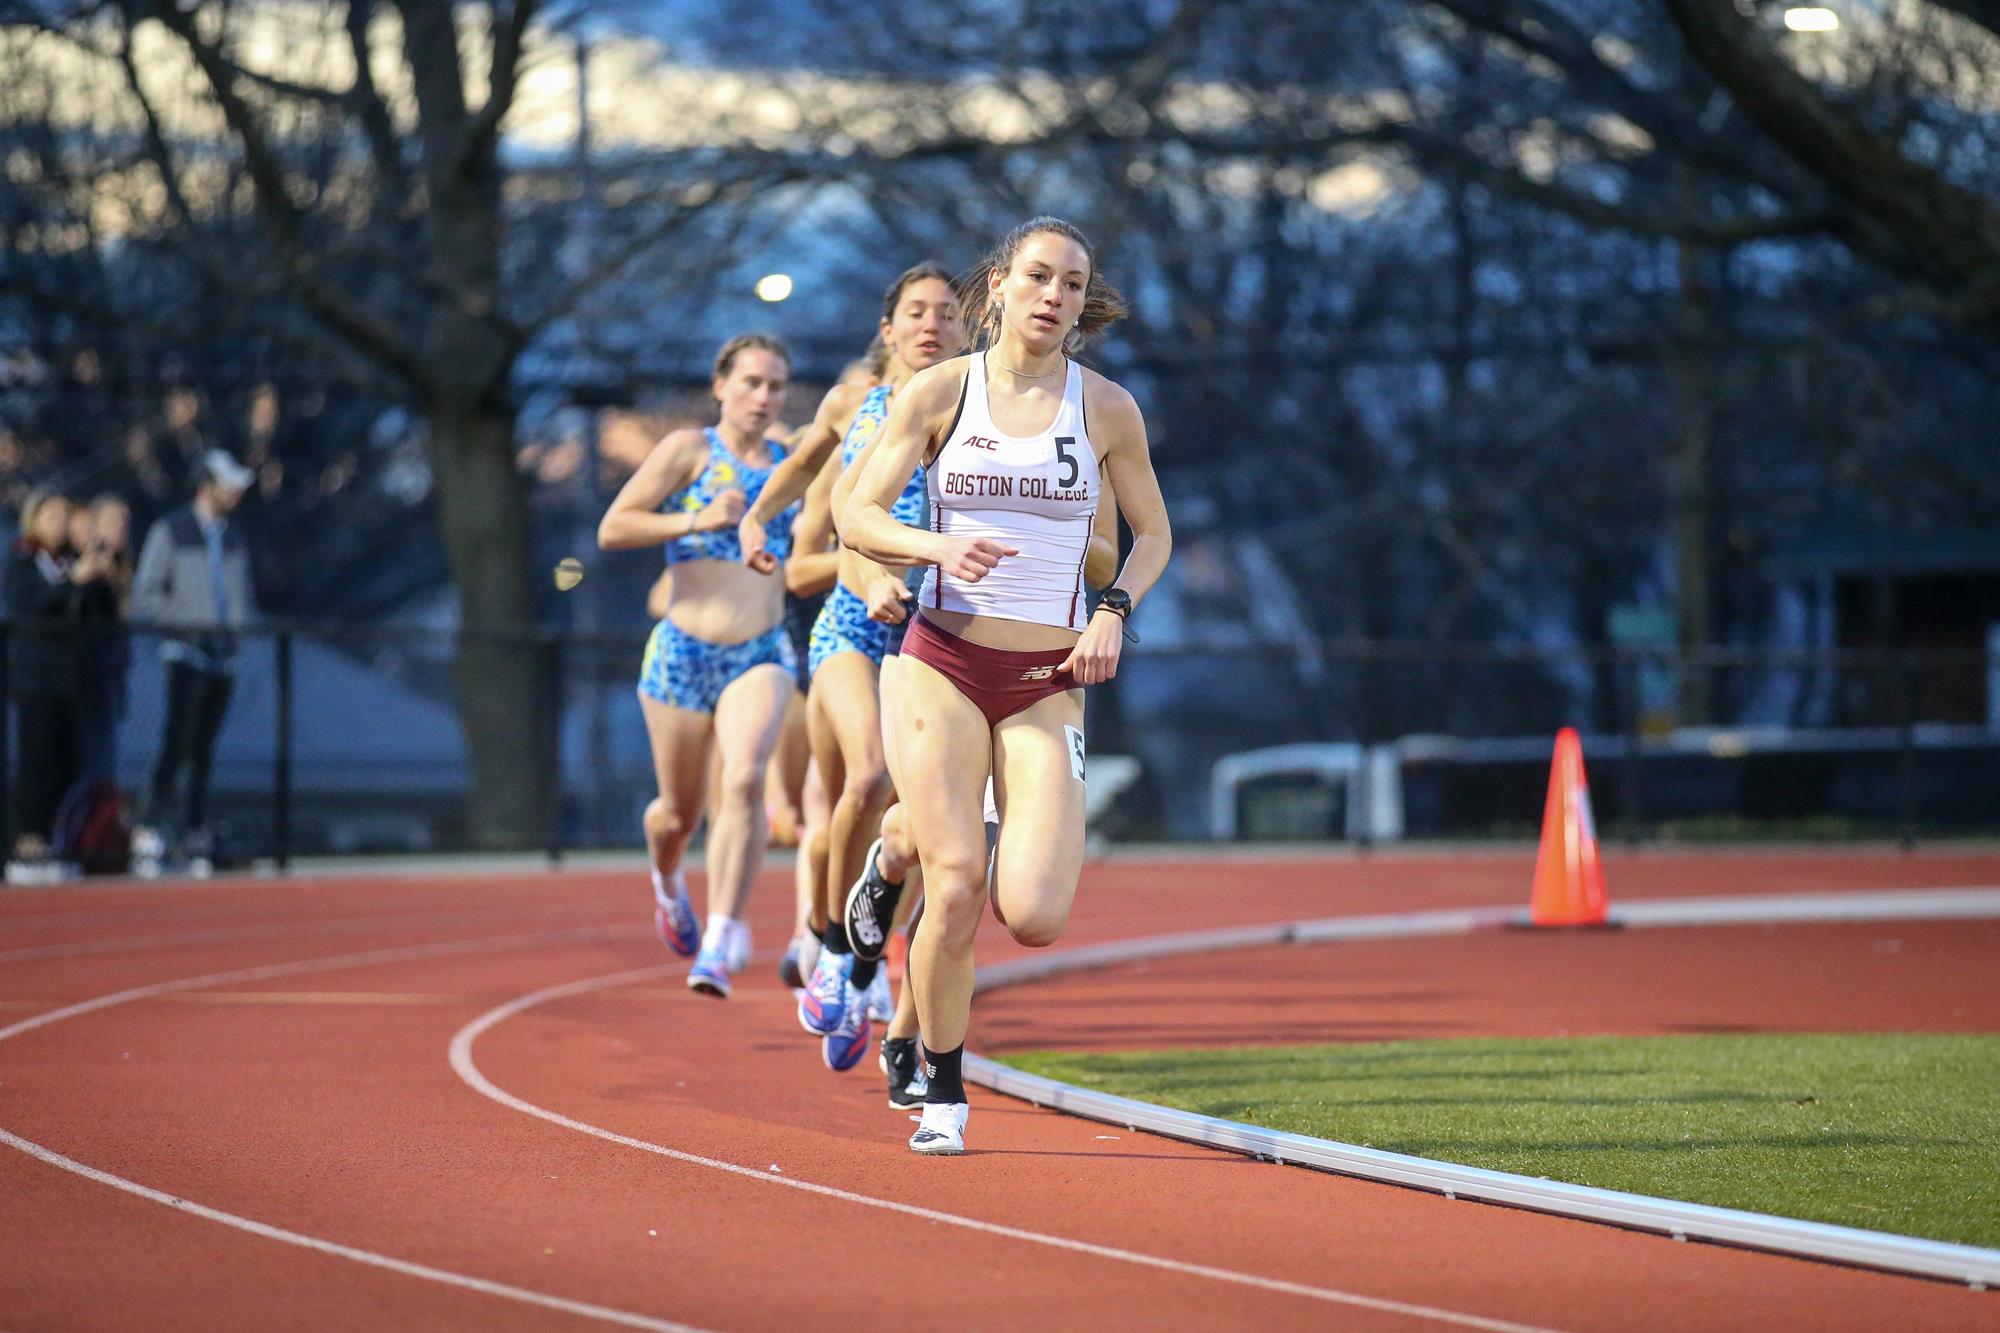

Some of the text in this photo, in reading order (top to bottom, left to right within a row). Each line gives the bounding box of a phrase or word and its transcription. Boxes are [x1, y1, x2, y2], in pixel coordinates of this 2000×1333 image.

[962, 435, 1000, 451] ACC
[1055, 437, 1079, 488] 5
[945, 472, 1013, 497] BOSTON
[1072, 731, 1086, 781] 5
